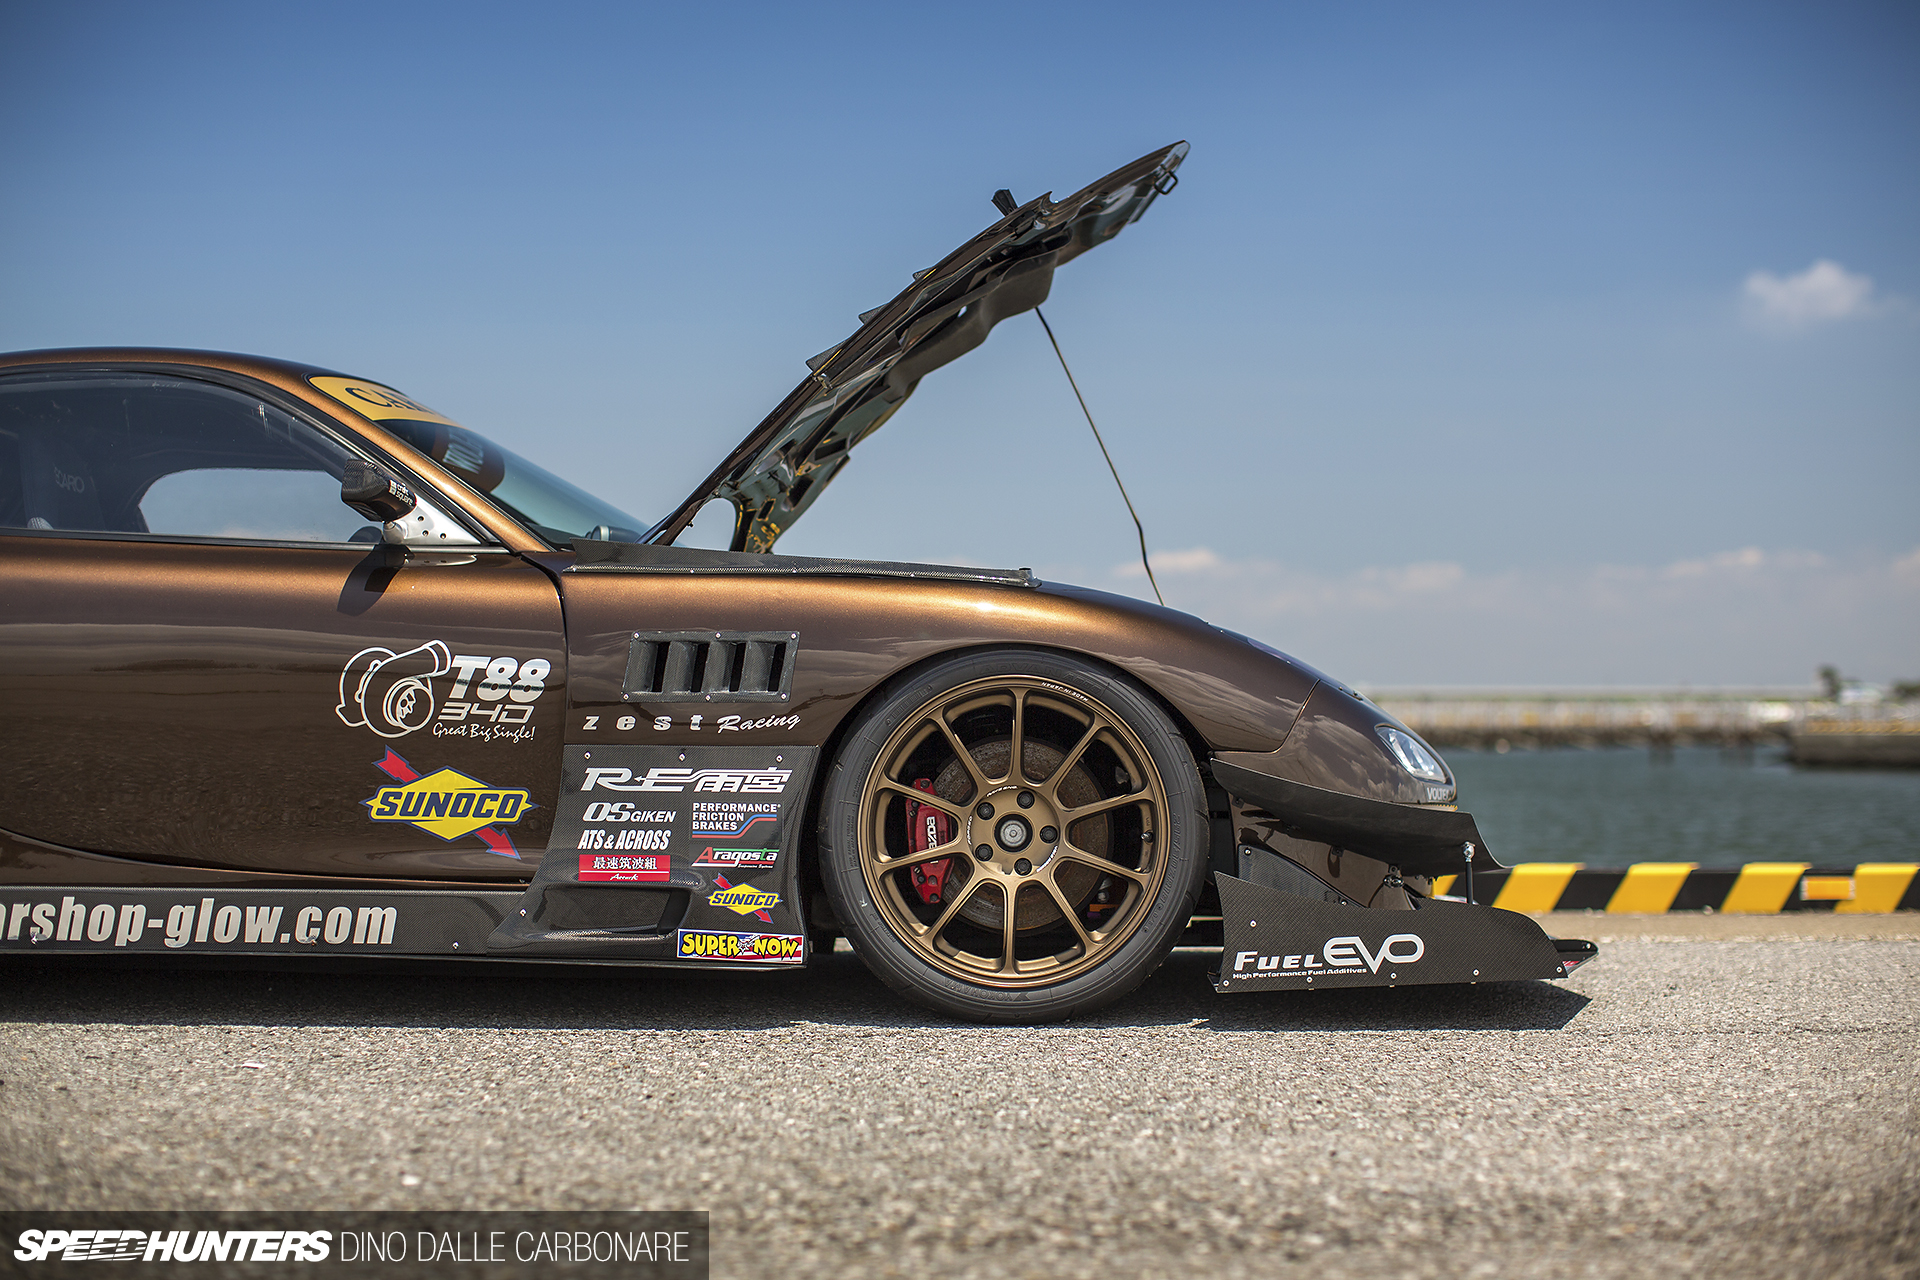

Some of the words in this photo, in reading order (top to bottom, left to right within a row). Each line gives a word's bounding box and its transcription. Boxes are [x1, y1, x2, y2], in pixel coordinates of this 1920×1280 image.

[449, 655, 551, 703] T88
[432, 722, 468, 739] Great
[469, 724, 492, 743] Big
[492, 725, 536, 744] Single!
[716, 713, 801, 734] Racing
[375, 791, 524, 819] SUNOCO
[692, 802, 778, 813] PERFORMANCE
[692, 812, 745, 822] FRICTION
[692, 821, 738, 831] BRAKES
[577, 829, 605, 850] ATS
[614, 829, 672, 850] ACROSS
[593, 856, 658, 870] 最速筑波組
[693, 846, 778, 867] Aragosta
[711, 892, 777, 906] SUNOCO
[0, 896, 398, 948] rshop-glow.com
[680, 932, 741, 958] SUPER
[752, 936, 799, 960] NOW
[1232, 972, 1253, 980] High
[1252, 970, 1307, 979] Performance
